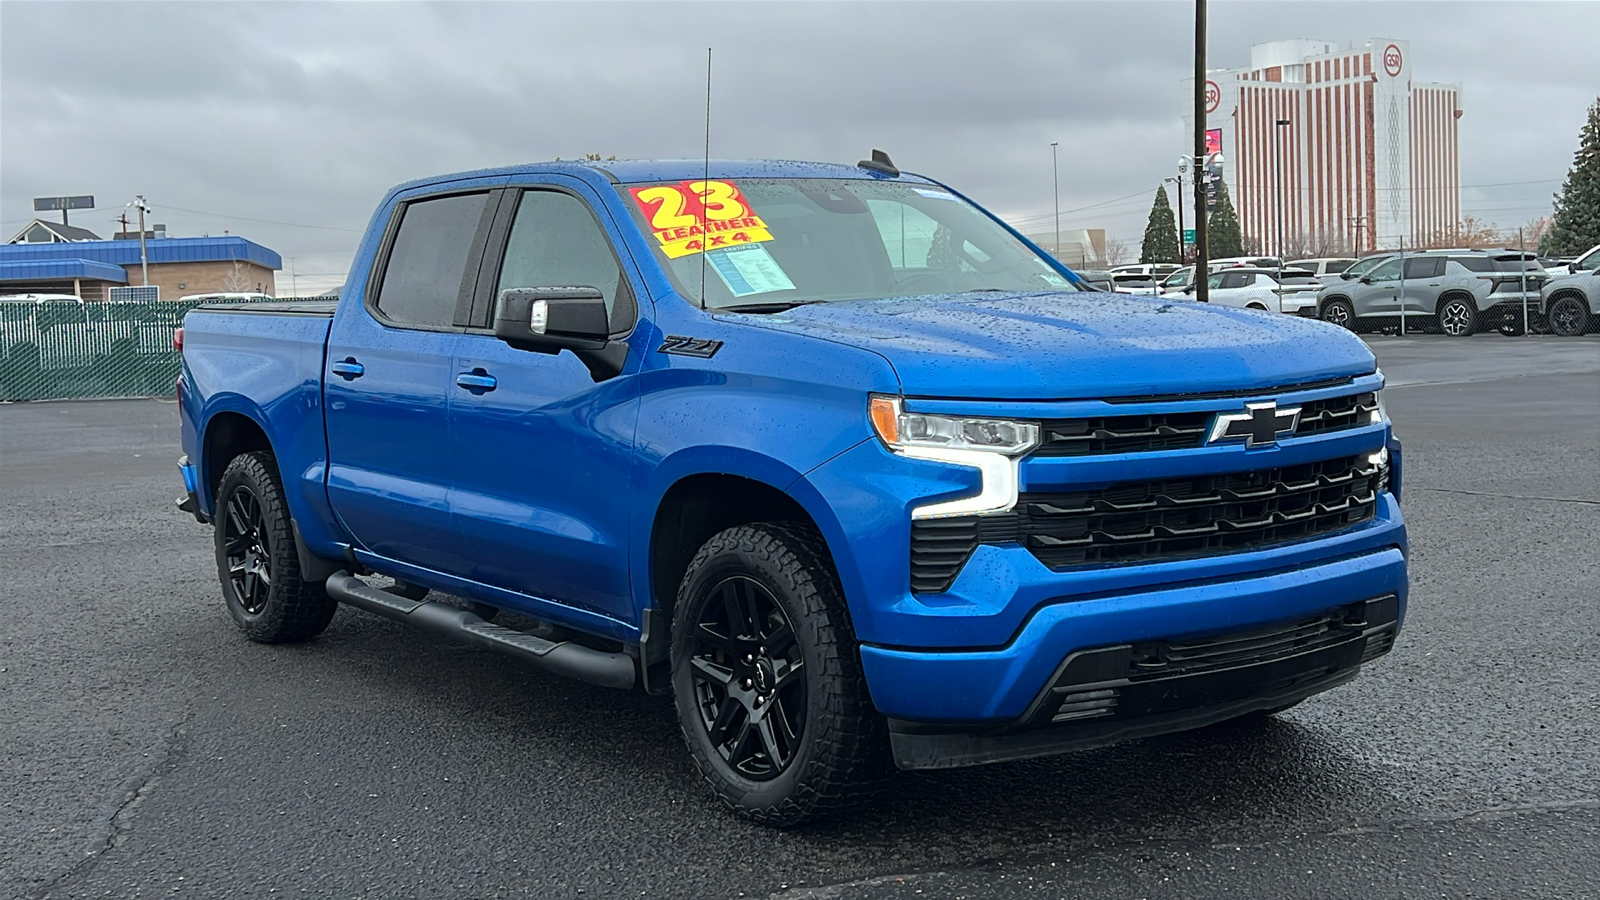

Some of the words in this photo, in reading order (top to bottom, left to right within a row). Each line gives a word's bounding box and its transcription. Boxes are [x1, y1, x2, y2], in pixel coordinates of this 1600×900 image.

[1386, 53, 1400, 67] GSR
[1205, 89, 1217, 104] SR
[637, 181, 748, 229] 23
[662, 218, 757, 242] LEATHER
[724, 244, 758, 252] CERTIFIED
